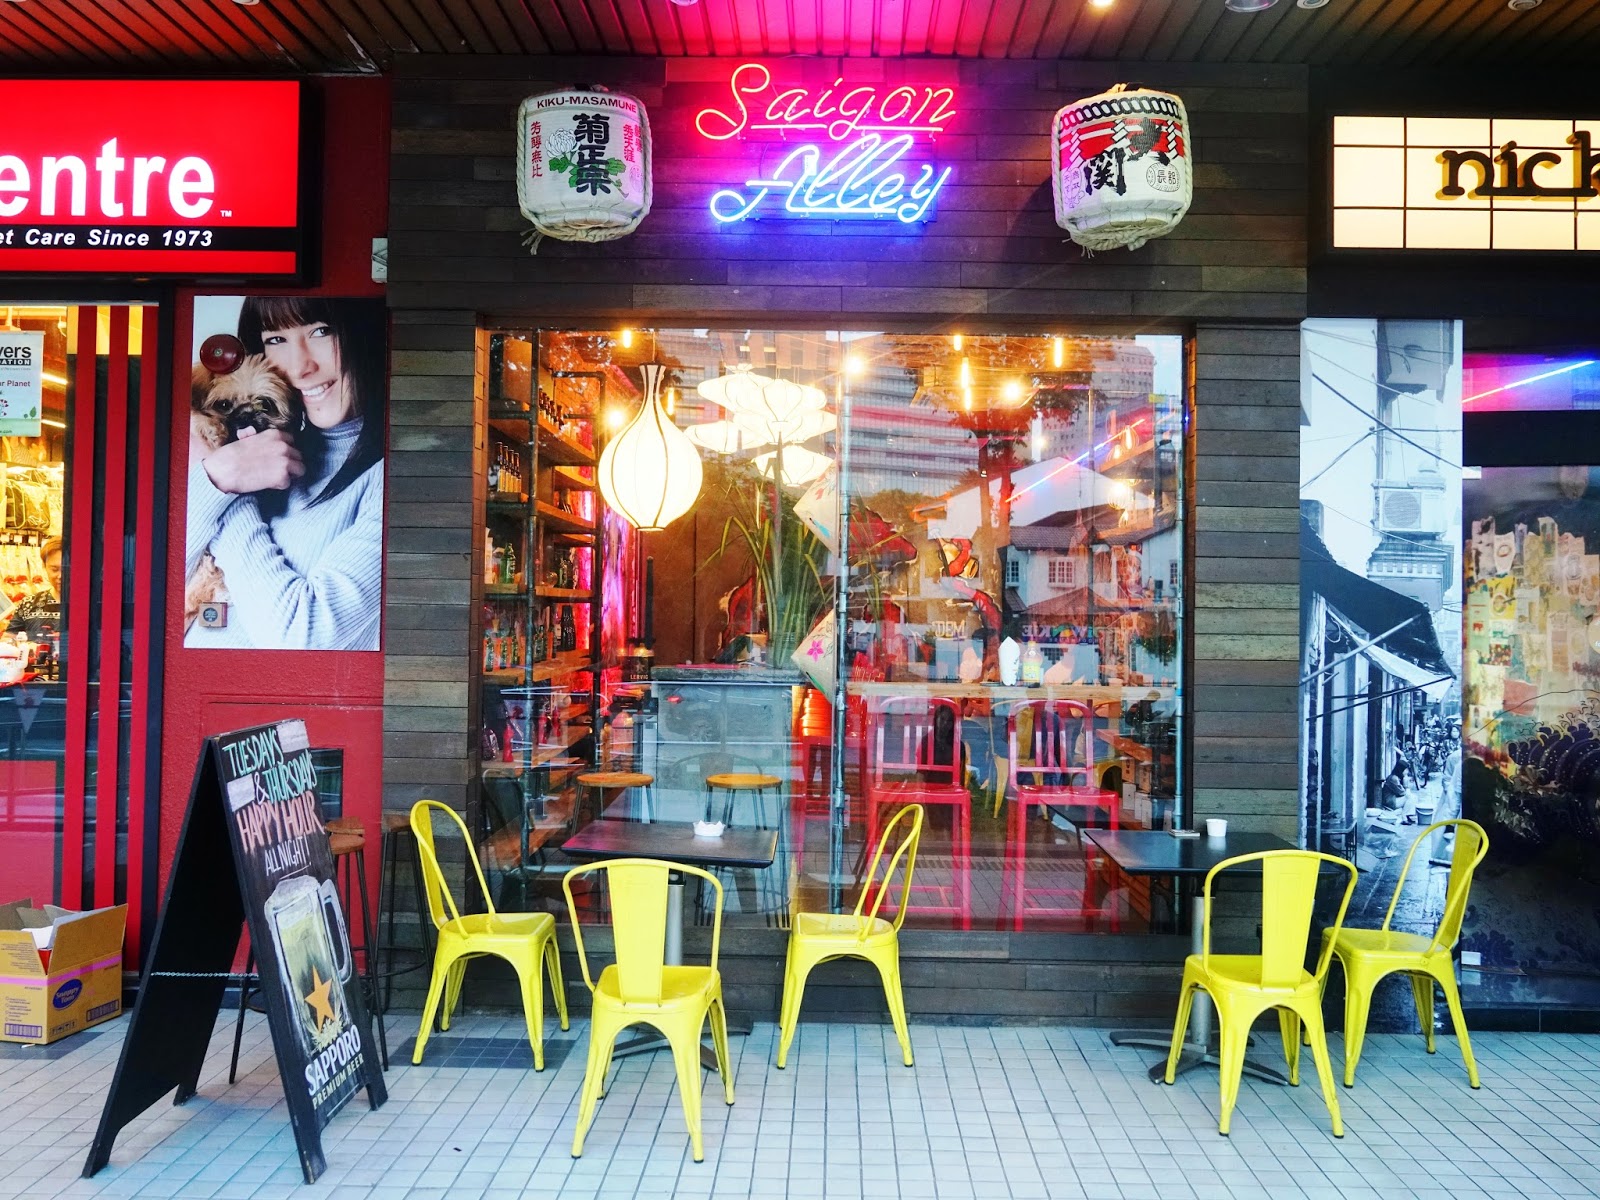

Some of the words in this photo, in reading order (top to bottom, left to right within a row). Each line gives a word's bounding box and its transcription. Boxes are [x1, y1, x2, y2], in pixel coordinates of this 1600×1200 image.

[537, 96, 637, 113] KIKU-MASAMUNE
[695, 63, 956, 141] Saigon
[0, 136, 215, 219] entre
[573, 113, 611, 196] 菊正宗
[710, 133, 952, 223] Alley
[25, 228, 76, 246] Care
[87, 228, 150, 246] Since
[162, 229, 214, 247] 1973
[7, 379, 31, 387] Planet
[222, 728, 284, 777] TUESDAYS
[262, 749, 318, 804] THURSDAYS
[236, 799, 284, 854] HAPPY
[281, 790, 326, 841] HOUR
[264, 848, 281, 877] ALL
[304, 1024, 361, 1096] SAPPORO
[312, 1070, 347, 1110] PREMIUM
[346, 1053, 365, 1076] BEER
